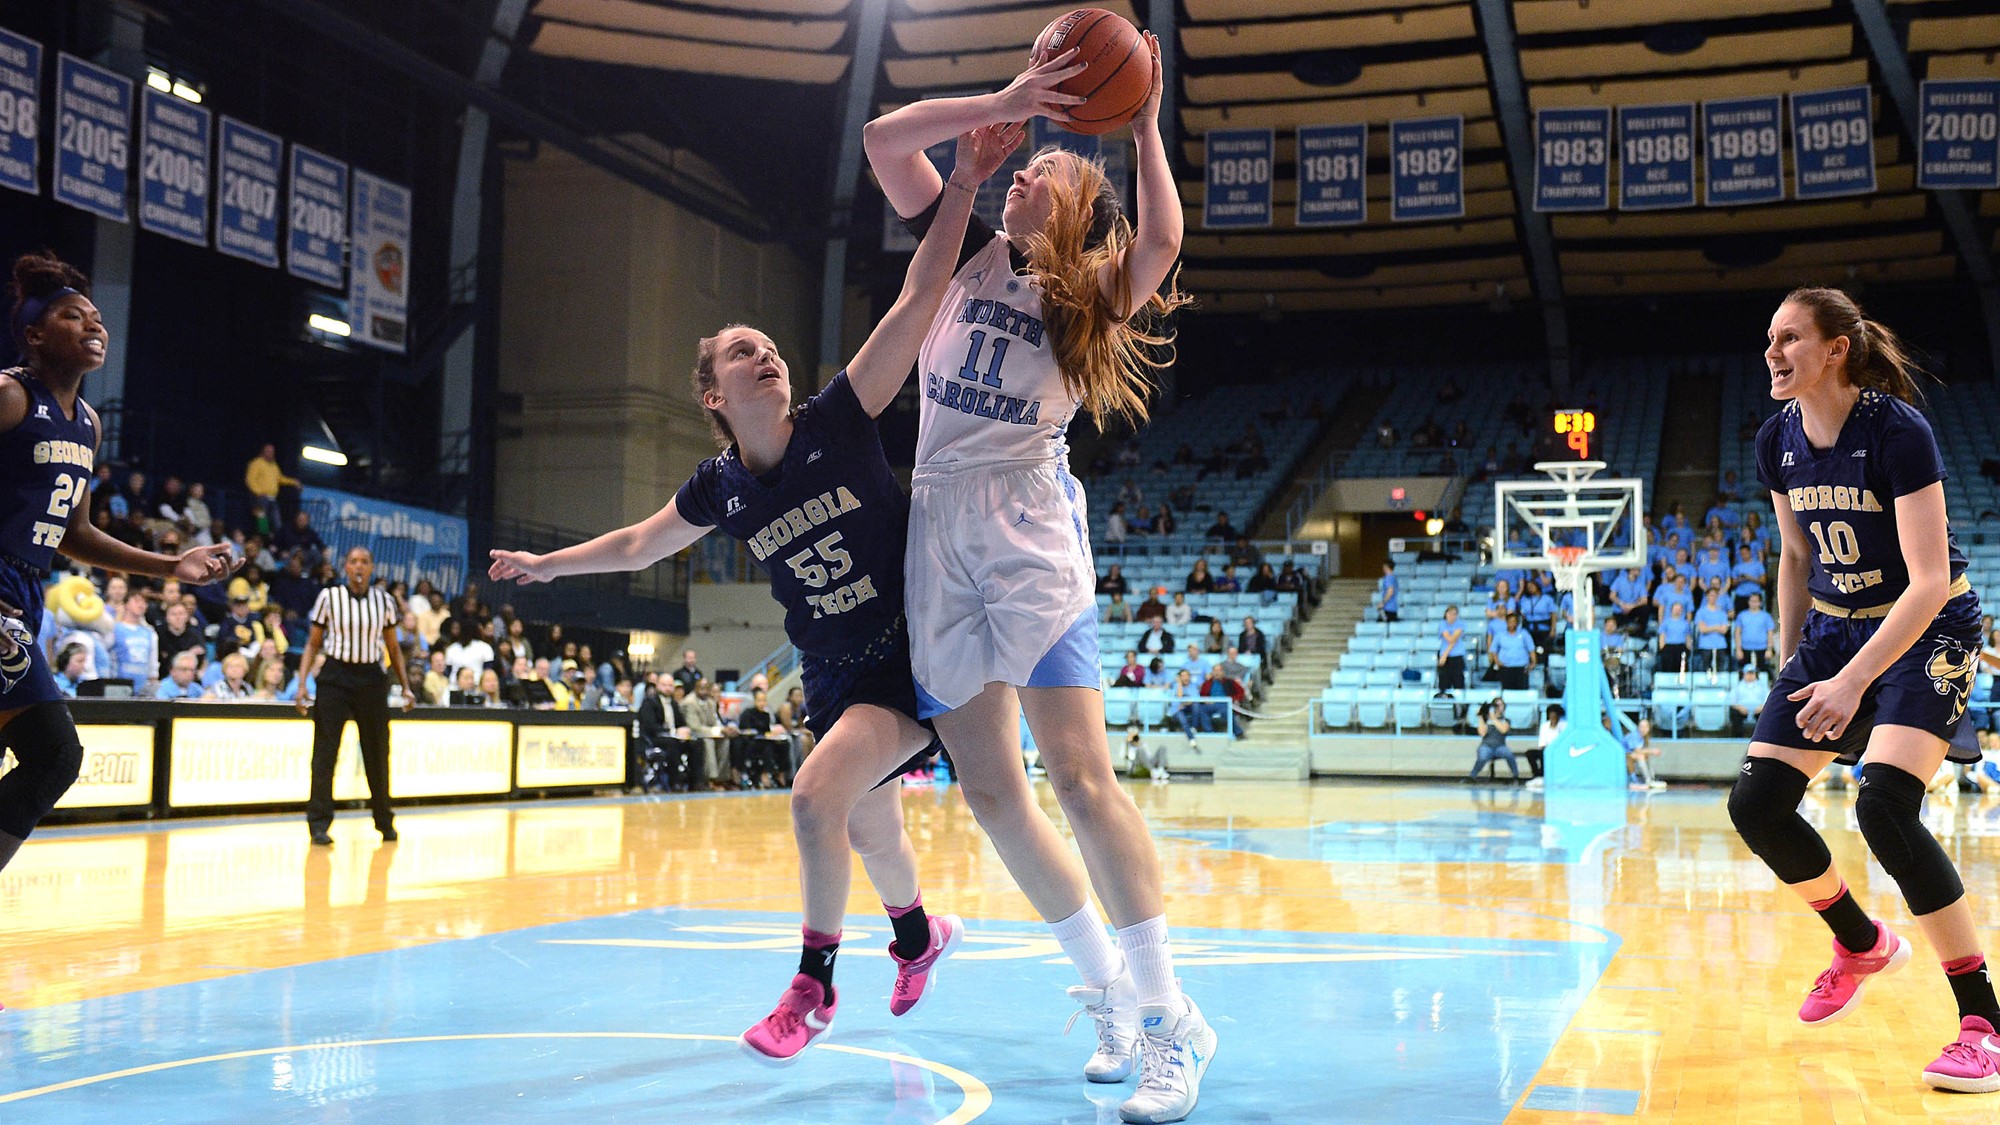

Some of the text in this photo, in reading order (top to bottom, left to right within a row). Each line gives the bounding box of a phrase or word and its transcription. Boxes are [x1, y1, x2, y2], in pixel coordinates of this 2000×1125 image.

[61, 112, 127, 170] 2005
[1798, 118, 1868, 151] 1999
[1924, 113, 1997, 140] 2000
[1542, 138, 1604, 166] 1983
[1625, 134, 1690, 165] 1988
[1710, 127, 1777, 160] 1989
[145, 143, 207, 197] 2006
[1211, 158, 1269, 185] 1980
[1303, 154, 1360, 183] 1981
[1397, 147, 1458, 176] 1982
[224, 170, 277, 220] 2007
[957, 298, 1045, 348] NORTH
[959, 329, 1010, 389] 11
[926, 372, 1041, 425] CAROLINA
[33, 440, 93, 473] GEORG
[1568, 431, 1588, 459] 9
[32, 521, 66, 549] TE
[747, 486, 862, 561] GEORGIA
[785, 530, 853, 588] 55
[1809, 521, 1861, 565] 10
[805, 574, 878, 619] TECH
[1824, 569, 1883, 594] ECH
